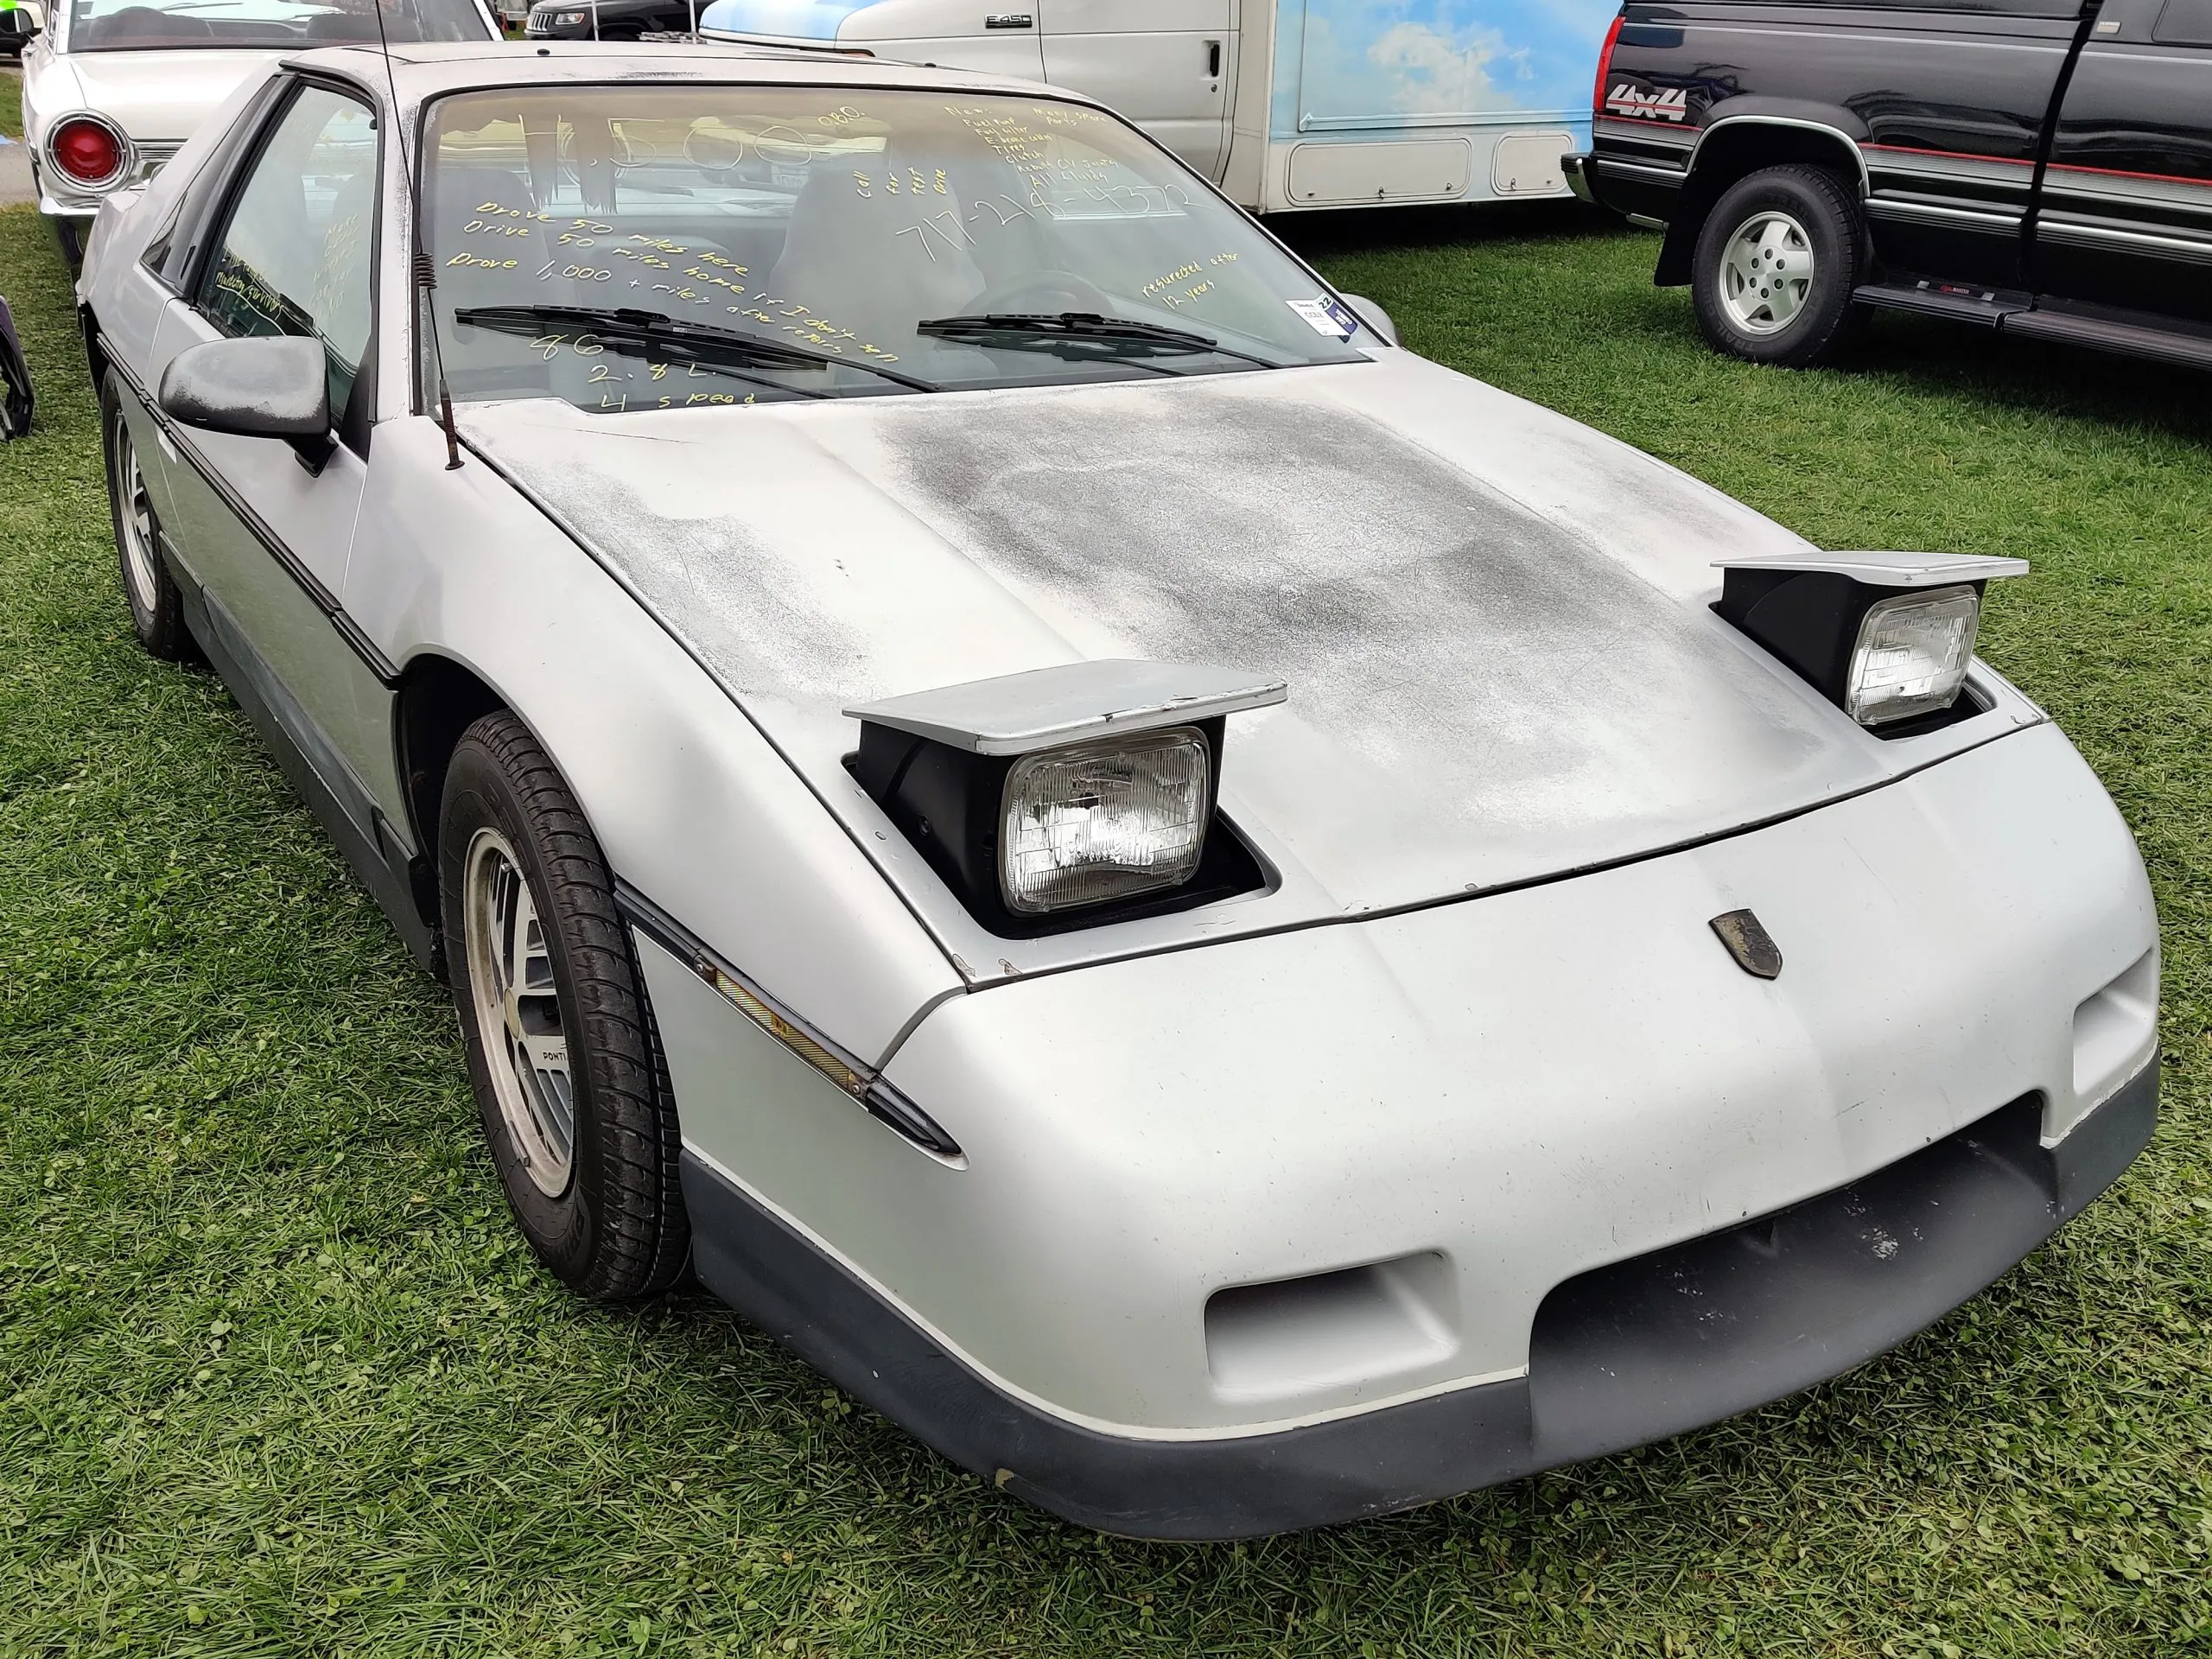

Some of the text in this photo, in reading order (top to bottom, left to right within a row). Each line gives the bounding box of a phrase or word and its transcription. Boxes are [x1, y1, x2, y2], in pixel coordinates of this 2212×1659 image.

[986, 15, 1033, 24] E-450
[1606, 84, 1687, 121] 4x4
[1057, 158, 1076, 170] CV
[476, 201, 749, 277] Drove 50 miles here
[463, 219, 531, 236] Drive
[556, 232, 596, 247] 50
[612, 247, 671, 270] miles
[683, 266, 746, 295] home
[536, 259, 613, 282] 1,000
[652, 283, 711, 305] miles
[1161, 295, 1185, 311] 12
[1319, 296, 1332, 309] 22
[530, 334, 604, 360] 86
[601, 394, 627, 412] 4
[543, 1051, 569, 1062] PONTI
